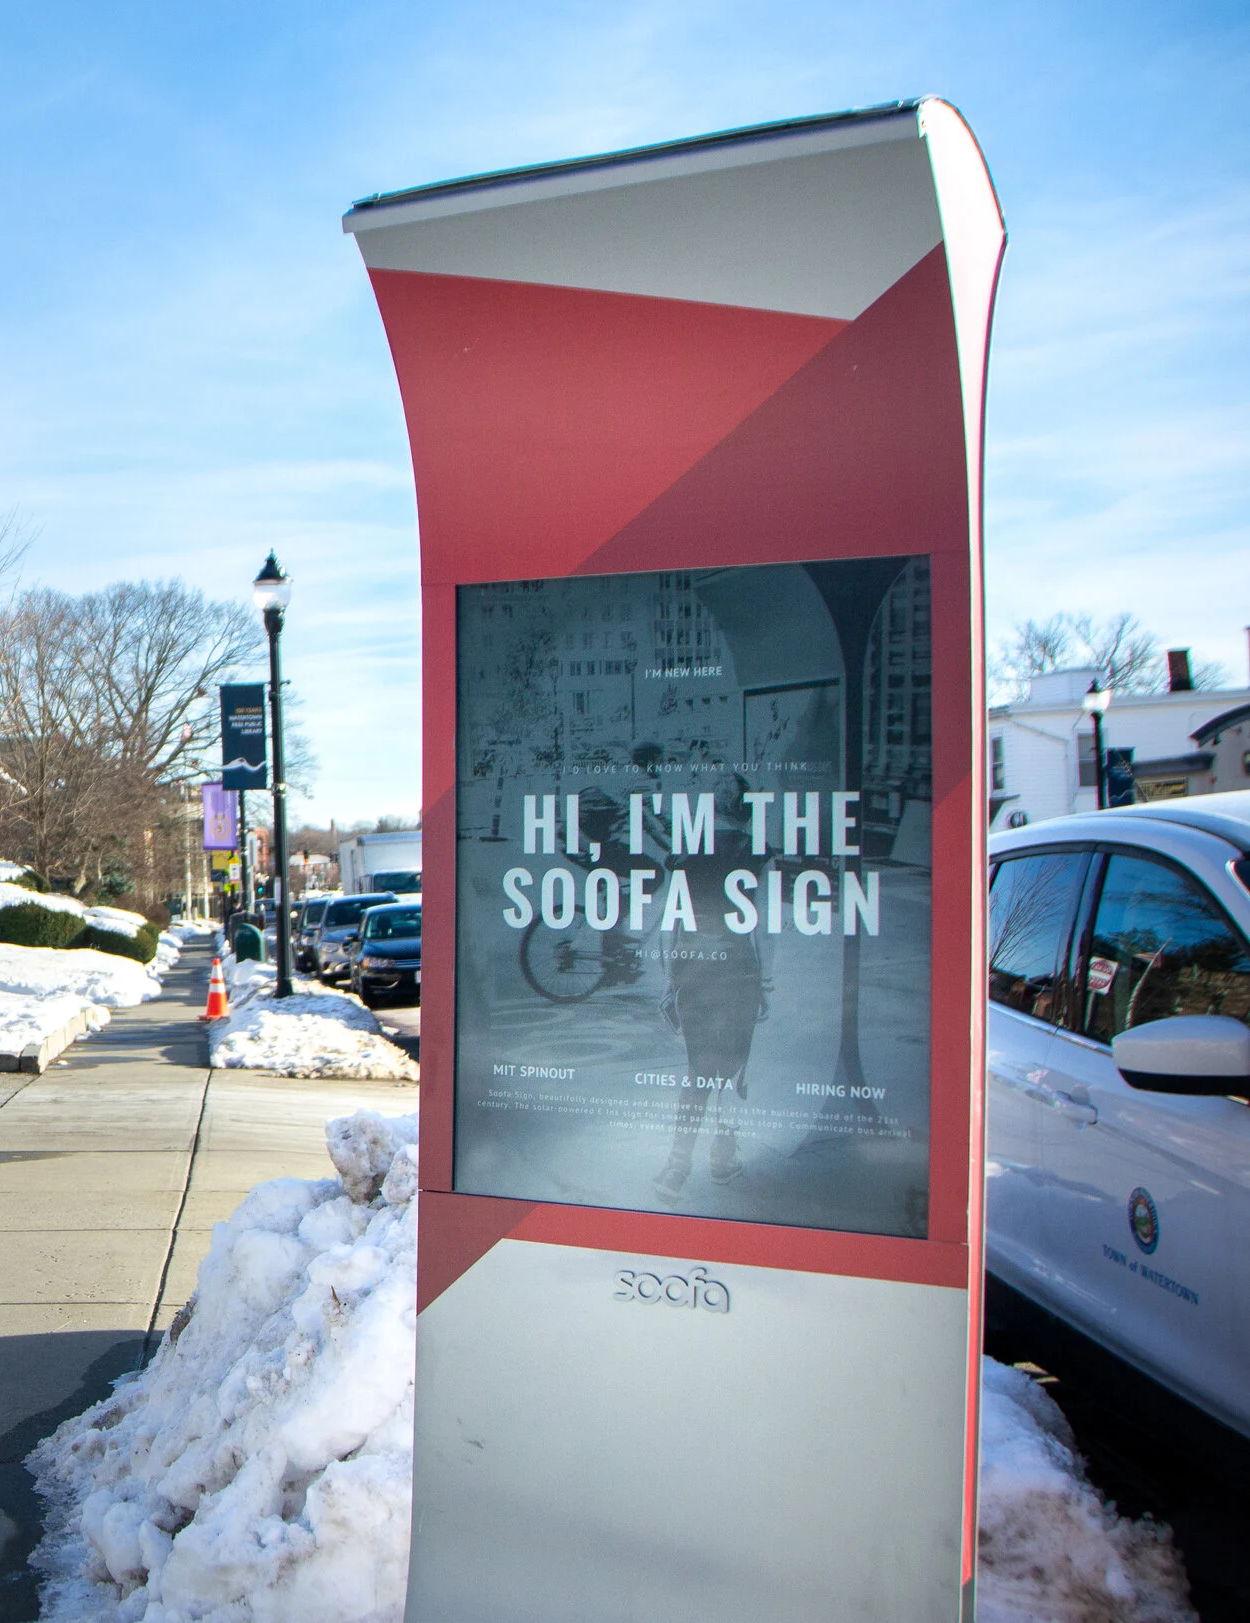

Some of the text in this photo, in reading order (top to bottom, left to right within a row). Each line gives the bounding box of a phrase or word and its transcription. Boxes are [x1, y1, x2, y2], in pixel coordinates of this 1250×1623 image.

[644, 665, 723, 679] I'M NEW HERE
[241, 727, 263, 735] LIBRARY
[586, 764, 617, 774] LOVE
[624, 764, 639, 773] TO
[647, 764, 683, 773] KNOW
[690, 762, 725, 772] WHAT
[733, 762, 759, 772] YOU
[766, 761, 807, 771] THINK
[523, 791, 861, 863] HI, I'M THE
[502, 866, 880, 937] SOOFA SIGN
[635, 949, 728, 961] HI@SOOFA.CO
[493, 1064, 575, 1080] MIT SPINOUT
[634, 1072, 734, 1090] CITIES & DATA
[795, 1082, 886, 1100] HIRING NOW
[488, 1089, 512, 1098] Soofa
[539, 1093, 586, 1104] beautifully
[590, 1096, 629, 1107] designed
[632, 1100, 648, 1108] and
[652, 1101, 690, 1110] intuitive
[694, 1104, 704, 1112] to
[752, 1107, 767, 1115] the
[770, 1109, 809, 1118] bulletin
[812, 1111, 840, 1121] board
[844, 1113, 854, 1121] of
[857, 1115, 873, 1123] the
[515, 1101, 529, 1110] The
[532, 1103, 594, 1115] solar-powered
[622, 1111, 642, 1119] sign
[644, 1111, 658, 1119] for
[661, 1113, 686, 1121] smart
[690, 1114, 714, 1124] parks
[718, 1116, 734, 1125] and
[738, 1118, 754, 1126] bus
[789, 1121, 854, 1134] Communicate
[857, 1127, 875, 1135] bus
[878, 1129, 912, 1138] arrival
[640, 1124, 665, 1132] event
[668, 1125, 710, 1135] programs
[713, 1128, 730, 1136] and
[1102, 1244, 1199, 1306] TOWN of WATERTOWN
[613, 1266, 730, 1314] soofa
